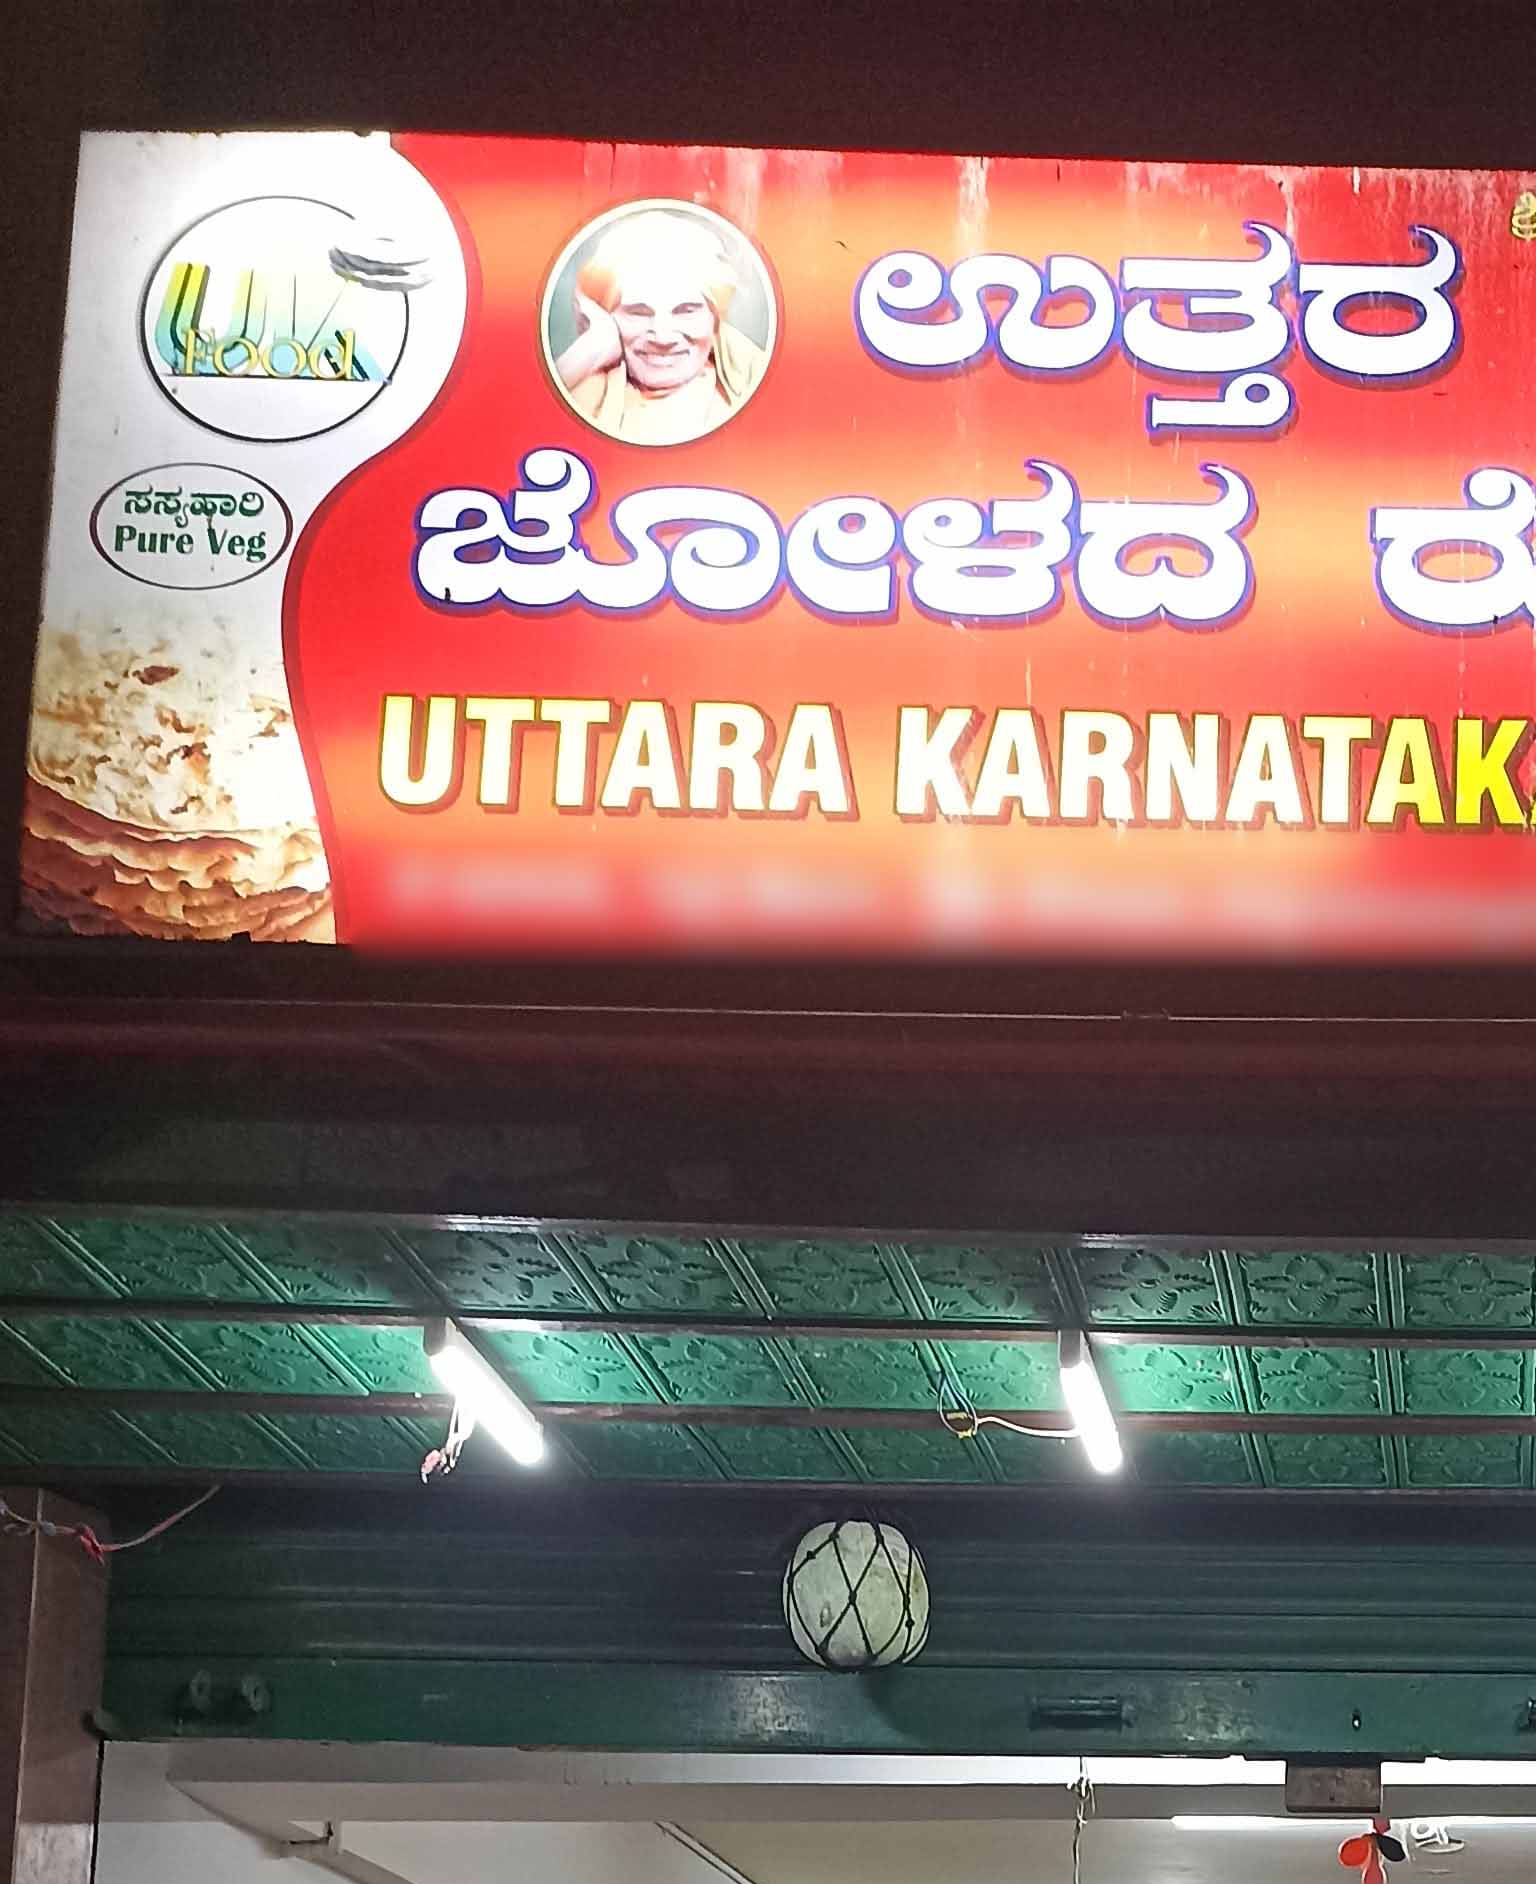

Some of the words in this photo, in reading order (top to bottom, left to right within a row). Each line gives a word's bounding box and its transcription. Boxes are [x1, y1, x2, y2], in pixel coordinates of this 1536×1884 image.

[184, 327, 357, 381] Food
[856, 221, 1460, 437] ಉತ್ತರ
[114, 525, 195, 554] Pure
[207, 527, 267, 562] Veg
[124, 485, 265, 528] ಸಸ್ಯಹಾರಿ
[412, 447, 1254, 624] ಜೋಳದ
[378, 694, 853, 816] UTTARA
